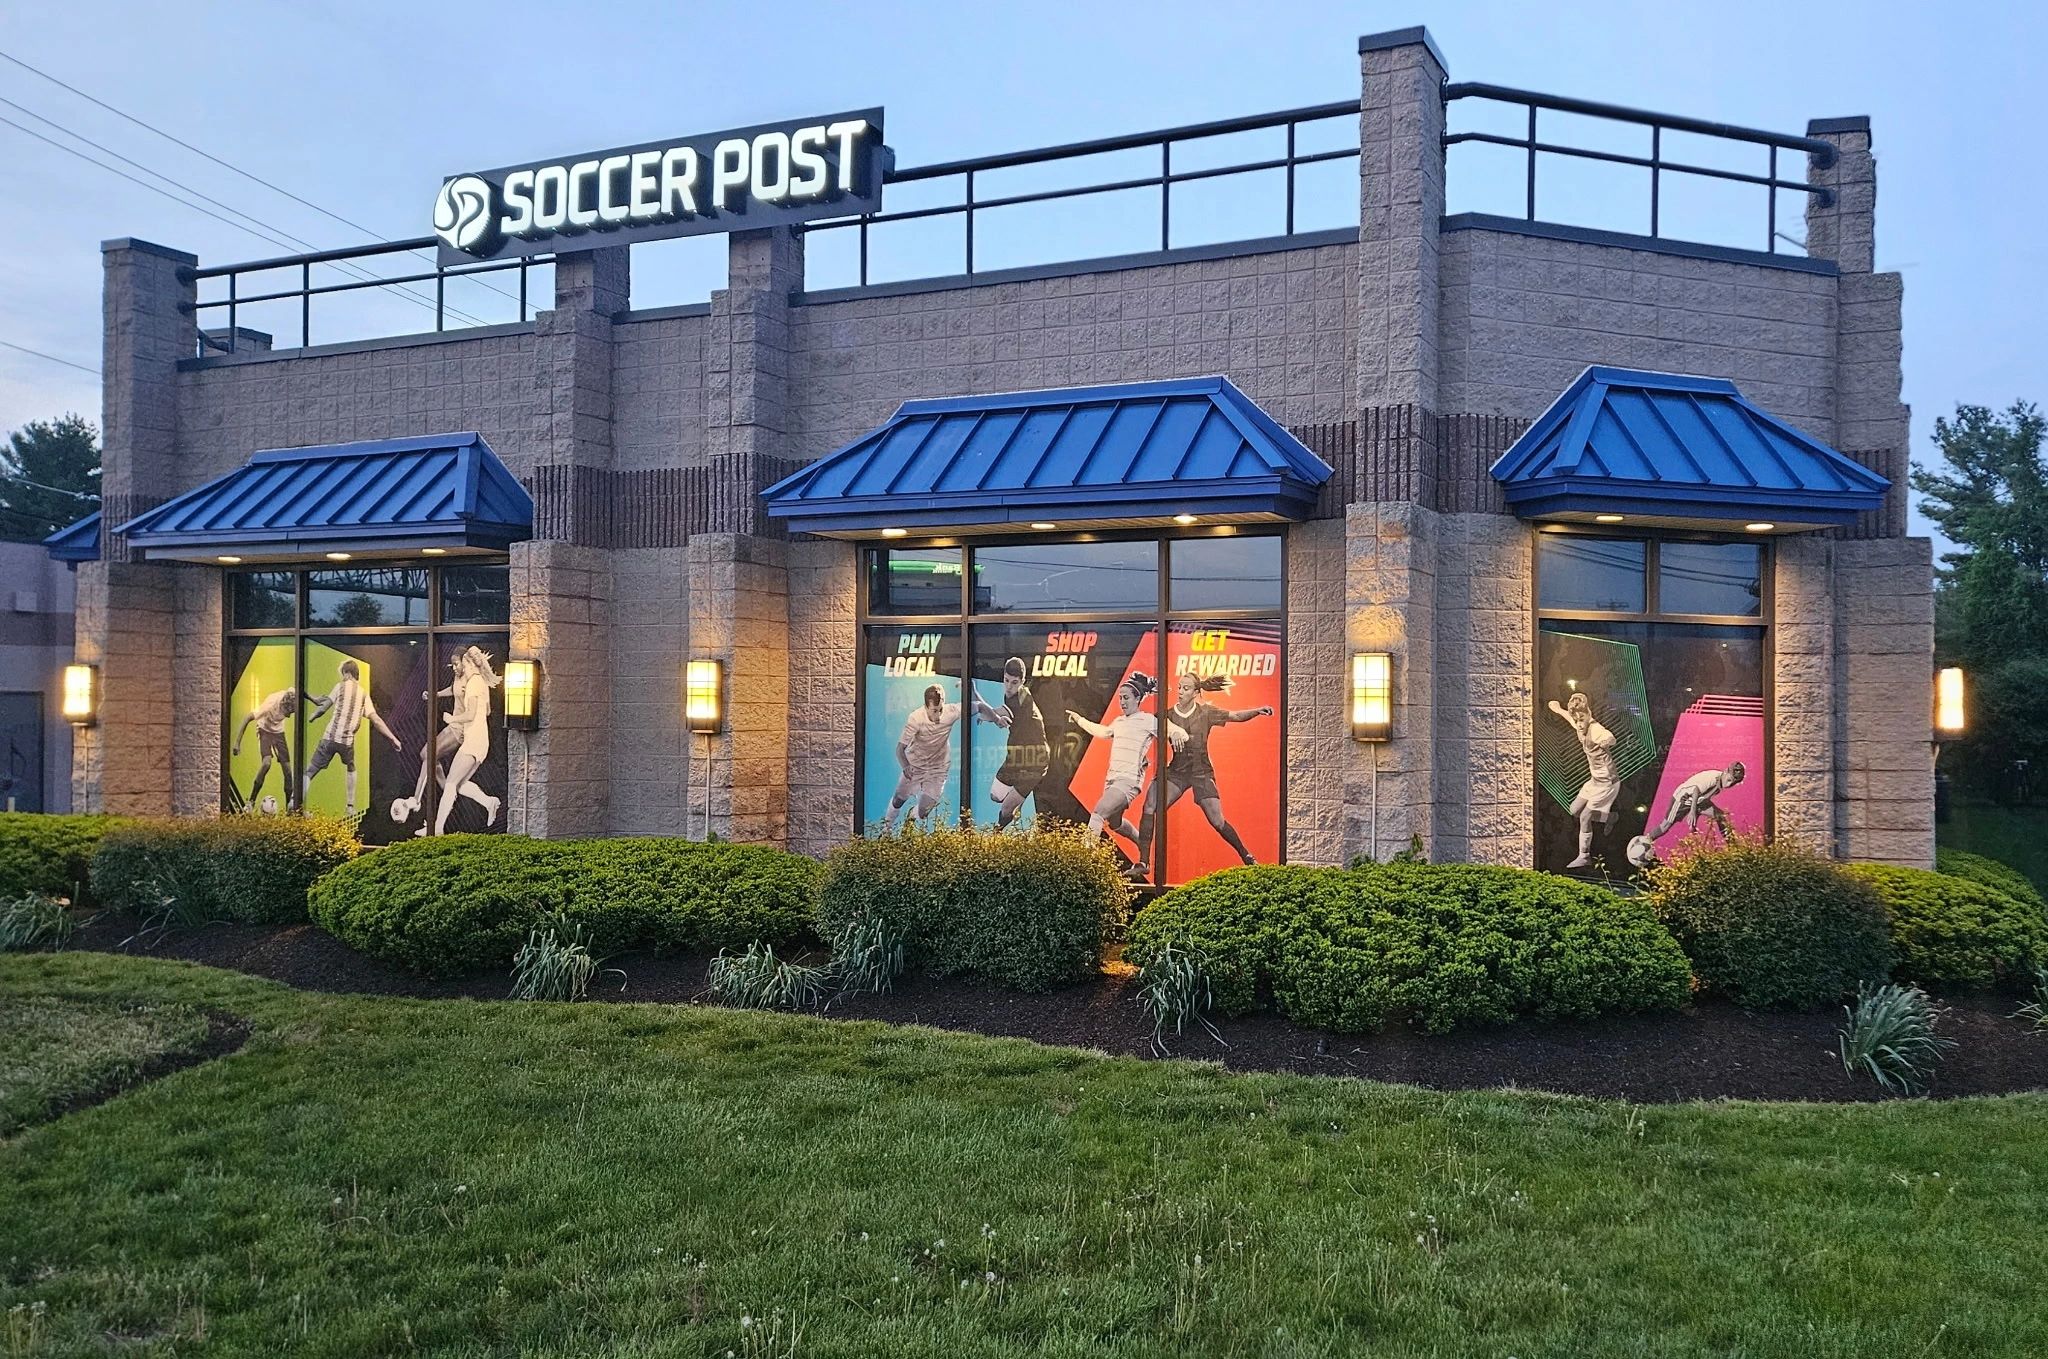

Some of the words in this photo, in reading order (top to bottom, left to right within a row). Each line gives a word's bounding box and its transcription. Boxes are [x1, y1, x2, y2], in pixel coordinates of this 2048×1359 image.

[501, 146, 697, 233] SOCCER
[713, 119, 867, 207] POST
[898, 634, 942, 653] PLAY
[1046, 631, 1098, 653] SHOP
[1192, 630, 1230, 651] GET
[884, 657, 936, 677] LOCAL
[1032, 655, 1088, 677] LOCAL
[1176, 654, 1276, 676] REWARDED
